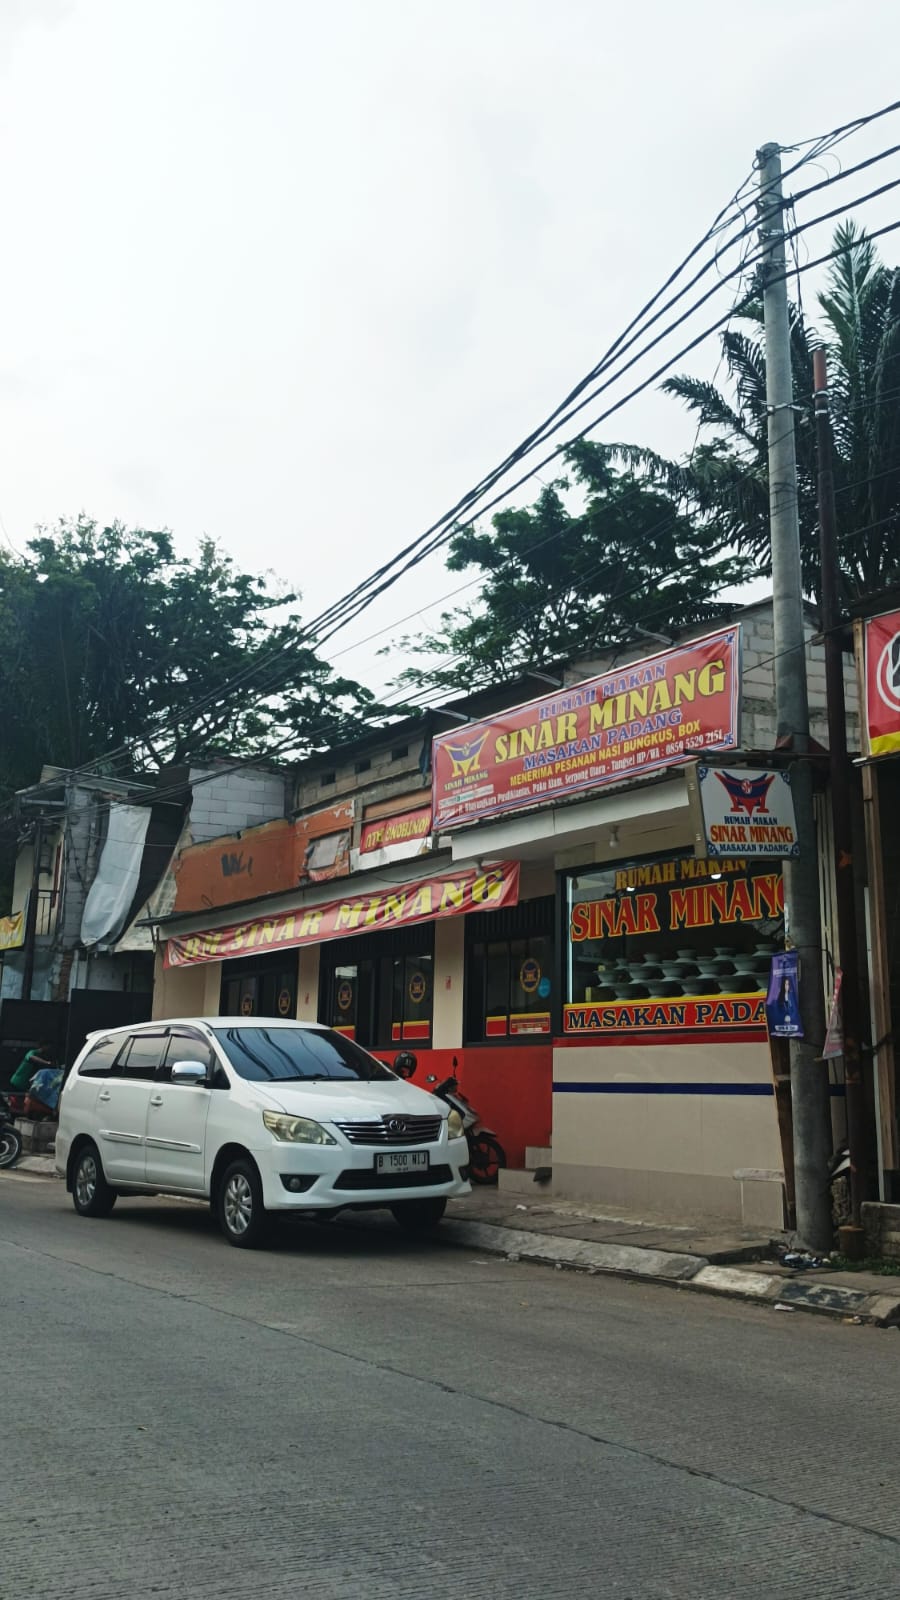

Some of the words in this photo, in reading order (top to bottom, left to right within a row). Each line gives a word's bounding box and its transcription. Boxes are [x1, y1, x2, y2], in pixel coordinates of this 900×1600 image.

[539, 687, 597, 720] RUMAH
[602, 662, 666, 698] MAKAN
[495, 712, 578, 763] SINAR
[589, 659, 726, 734] MINANG
[510, 767, 553, 787] MENERIMA
[555, 752, 597, 774] PESANAN
[598, 744, 621, 761] NASI
[623, 728, 675, 754] BUNGKUS,
[678, 719, 700, 737] BOX
[523, 733, 602, 771] MASAKAN
[607, 708, 682, 745] PADANG
[685, 735, 704, 751] 5529
[710, 825, 747, 842] SINAR
[749, 826, 794, 843] MINANG
[724, 815, 750, 825] RUMAH
[752, 816, 778, 825] MAKAN
[719, 843, 757, 852] MASAKAN
[760, 844, 789, 852] PADANG
[615, 862, 676, 890] RUMAH
[333, 869, 506, 931] MINANG
[570, 893, 660, 942] SINAR
[669, 873, 785, 931] MINAN
[567, 1005, 686, 1029] MASAKAN
[378, 1155, 384, 1168] B
[390, 1153, 408, 1167] 1500
